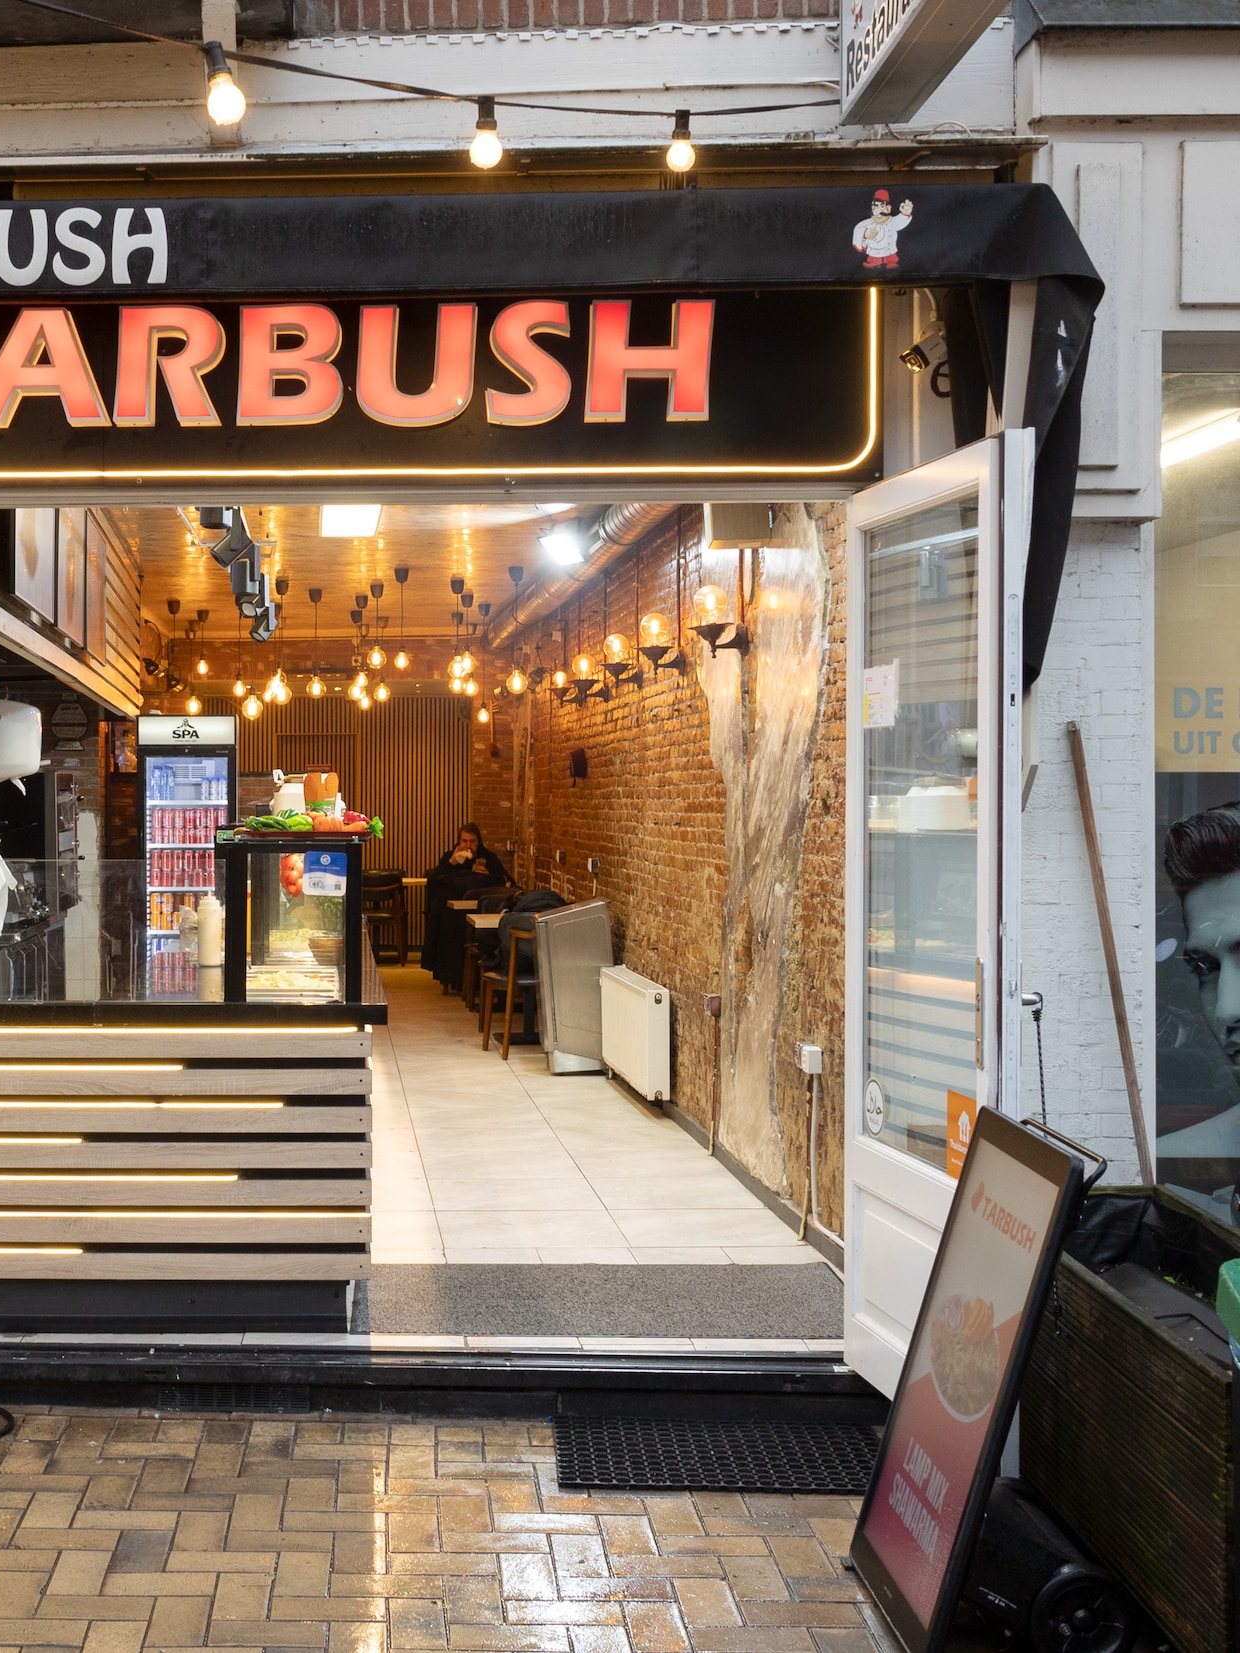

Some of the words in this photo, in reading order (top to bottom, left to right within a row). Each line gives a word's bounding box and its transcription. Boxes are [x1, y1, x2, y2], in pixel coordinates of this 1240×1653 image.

[1172, 687, 1224, 719] DE
[172, 729, 200, 739] SPA
[1172, 731, 1222, 755] UIT
[982, 1195, 1037, 1253] TARBUSH
[903, 1437, 932, 1489] LAMP
[925, 1465, 950, 1514] MIX
[889, 1472, 940, 1563] SHAWARMA
